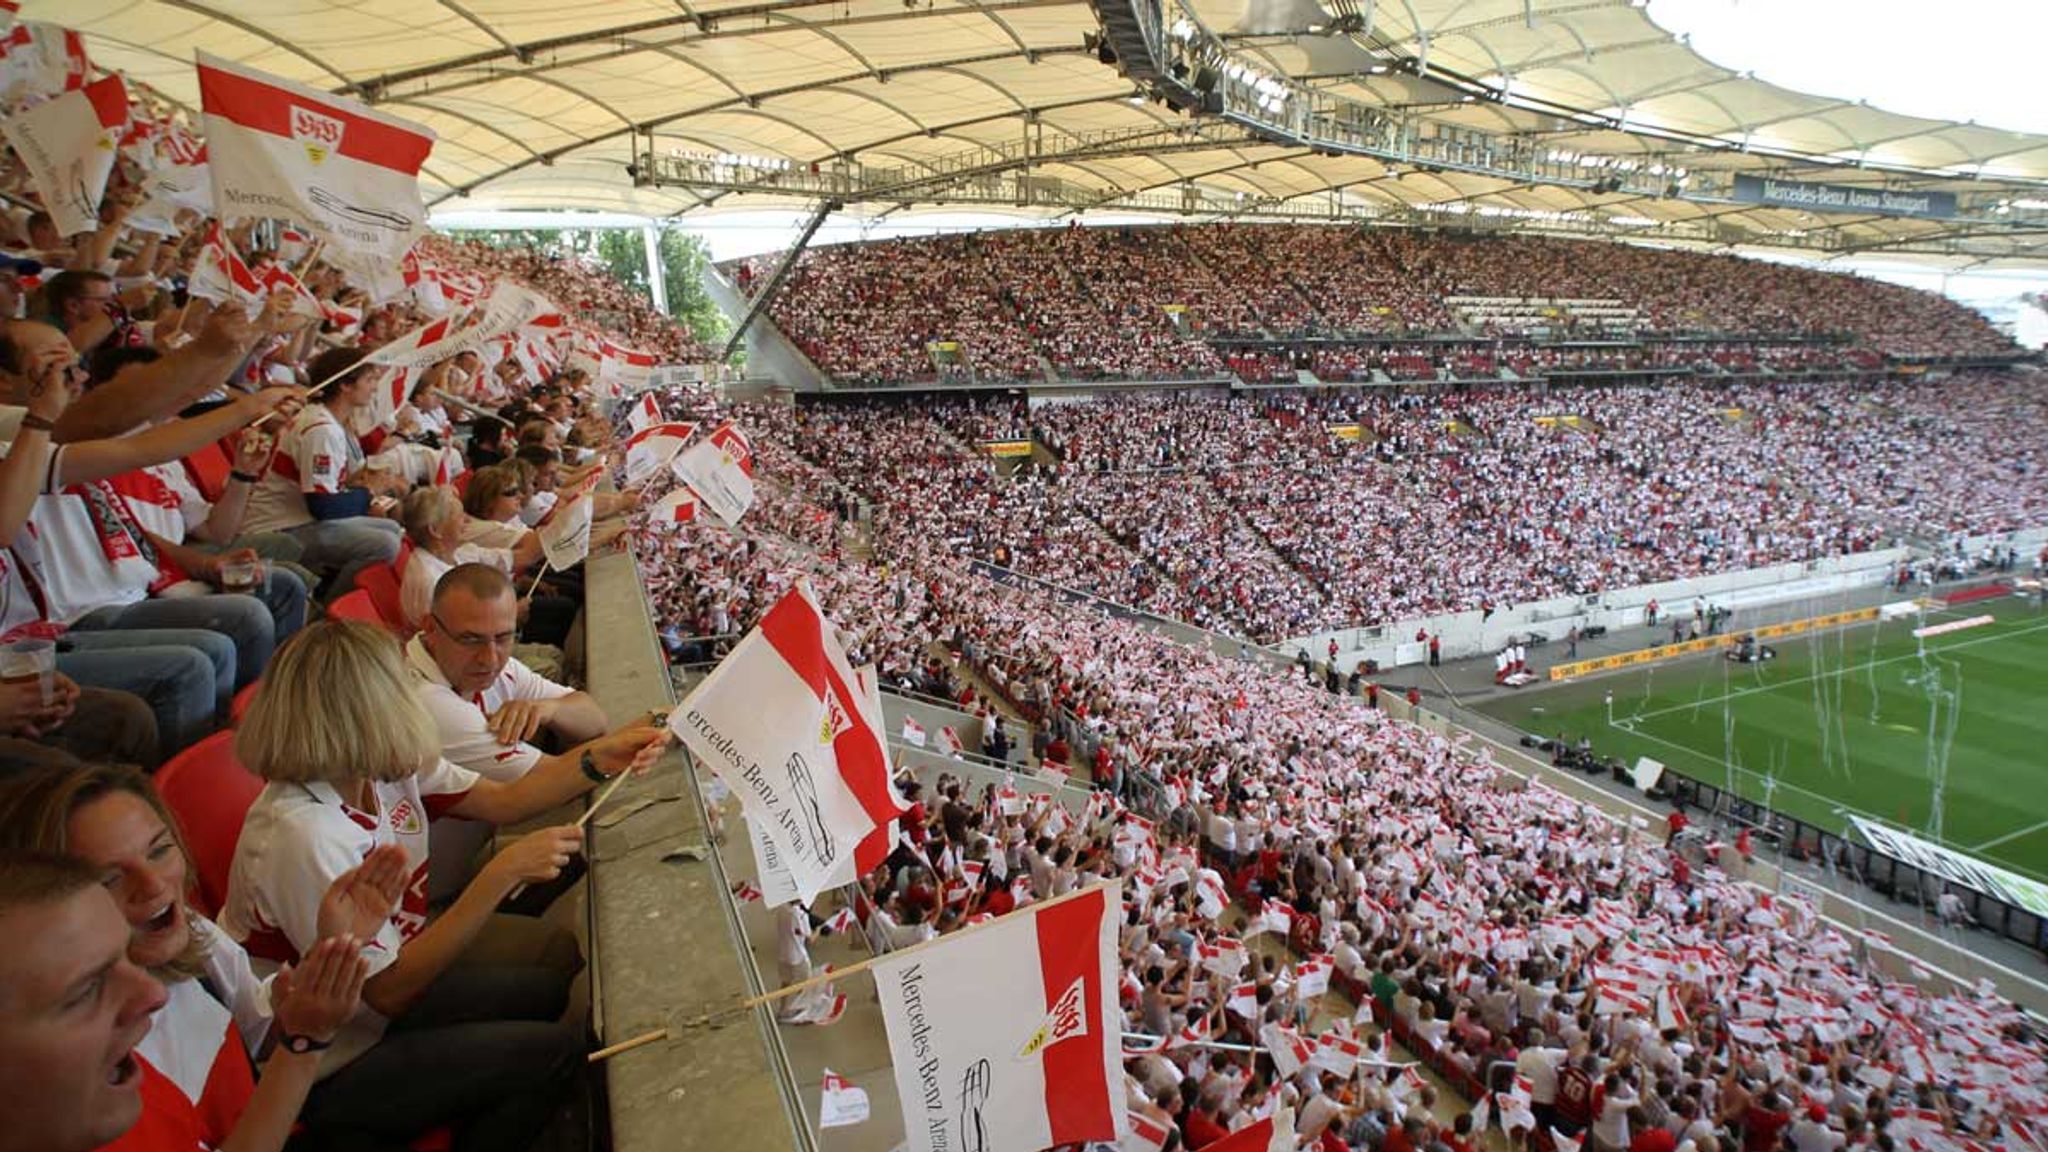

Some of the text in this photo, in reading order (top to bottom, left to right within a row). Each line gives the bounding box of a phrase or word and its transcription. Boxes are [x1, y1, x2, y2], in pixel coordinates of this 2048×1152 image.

[1763, 180, 1930, 214] Mercedes-Benz Arena Stuttgart
[686, 708, 806, 854] ercedes-Benz Arena
[899, 963, 949, 1152] Mercedes-Benz Aren
